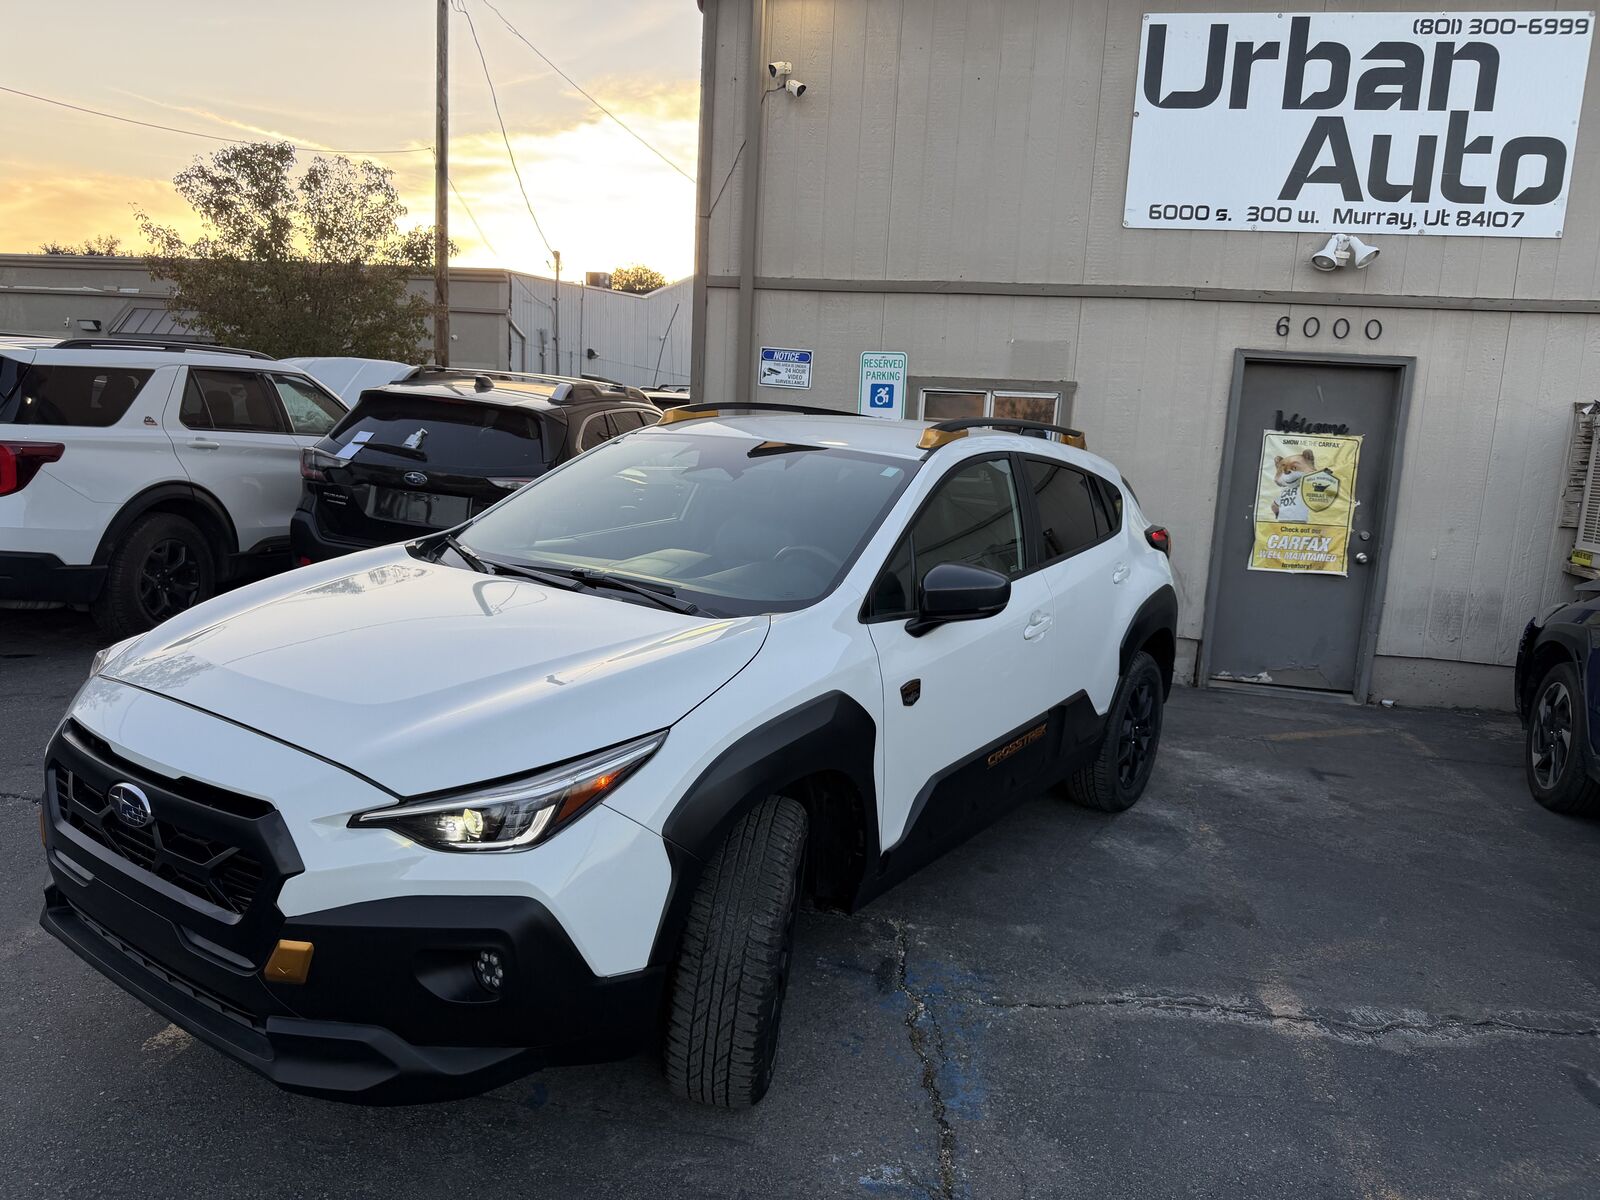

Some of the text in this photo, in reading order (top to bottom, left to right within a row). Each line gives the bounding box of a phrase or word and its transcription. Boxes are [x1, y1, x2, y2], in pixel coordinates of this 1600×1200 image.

[1413, 18, 1589, 35] (801) 300-6999
[1143, 16, 1500, 112] Urban
[1277, 110, 1567, 205] Auto
[1149, 204, 1210, 221] 6000
[1215, 208, 1232, 222] s.
[1246, 206, 1293, 223] 300
[1332, 208, 1416, 230] Murray,
[1424, 209, 1450, 226] Ut
[1455, 210, 1525, 228] 84107
[1276, 316, 1382, 340] 6000
[773, 351, 800, 361] NOTICE
[863, 358, 904, 369] RESERVED
[775, 378, 805, 386] SURVEILLANCE
[865, 370, 901, 381] PARKING
[1280, 487, 1298, 498] CAR
[1280, 497, 1296, 507] FOX
[1280, 525, 1299, 533] Check
[1267, 534, 1332, 552] CARFAX
[1258, 549, 1337, 562] WELL MAINTAINED
[987, 723, 1048, 767] CROSSTREK
